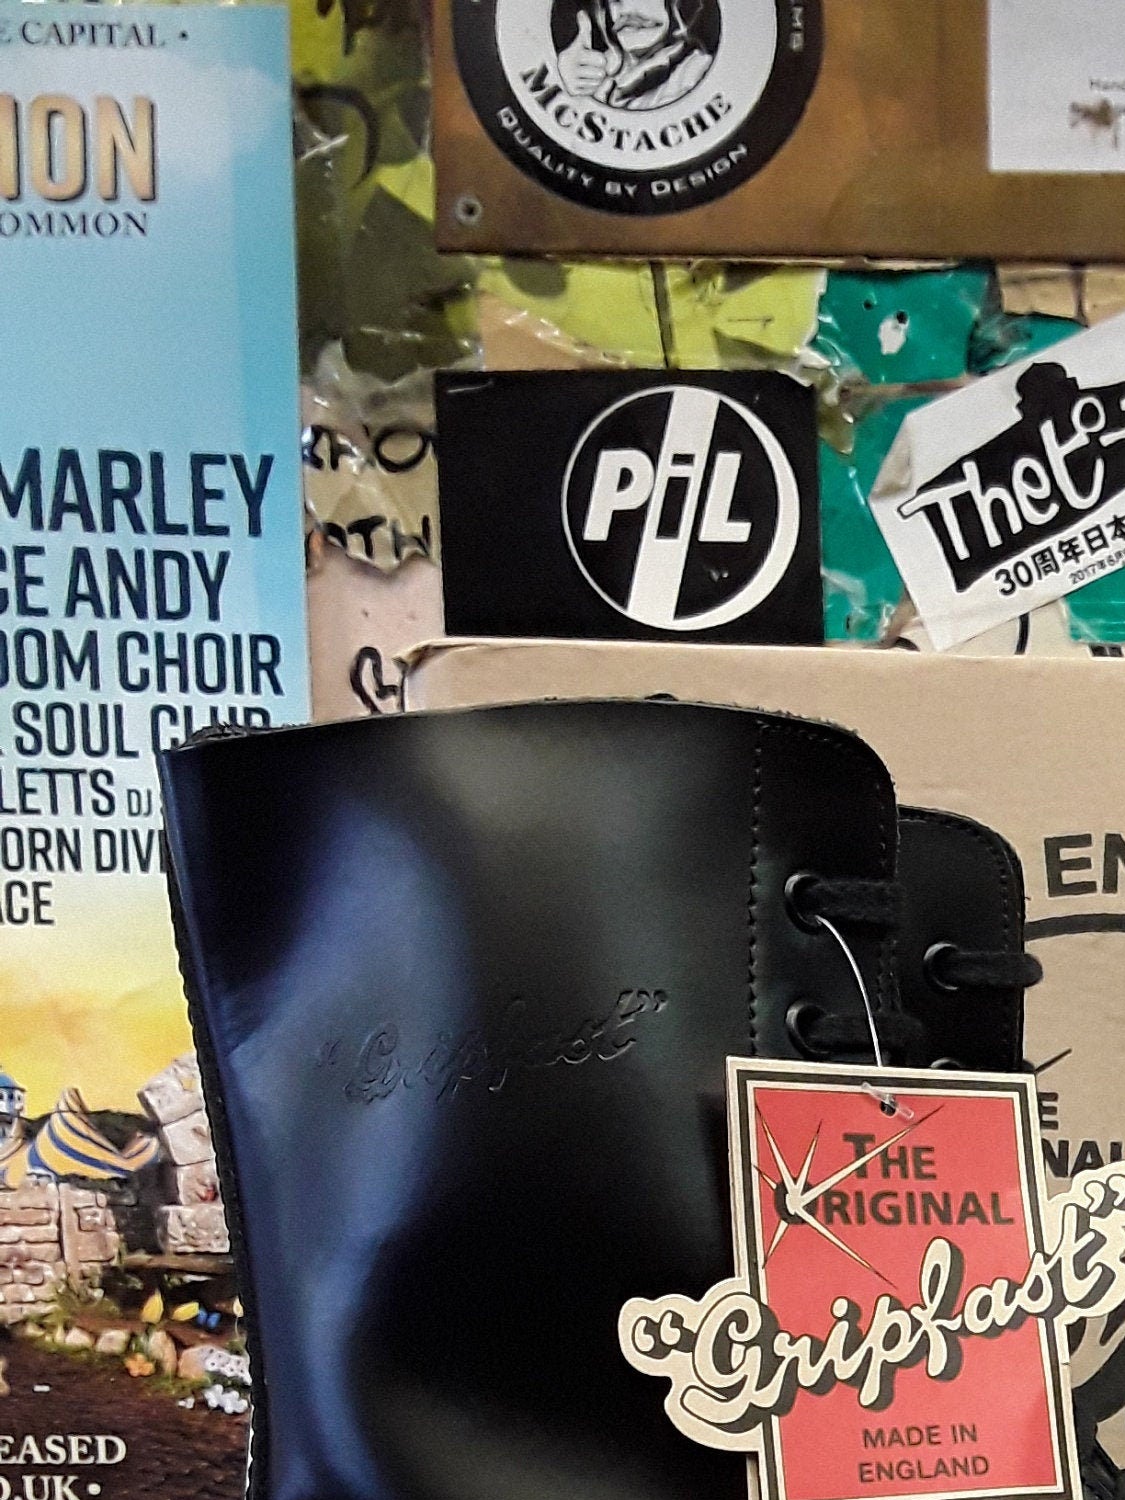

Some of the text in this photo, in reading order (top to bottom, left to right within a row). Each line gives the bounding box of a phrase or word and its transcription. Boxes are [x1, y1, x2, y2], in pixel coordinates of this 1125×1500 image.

[21, 20, 166, 46] CAPITAL
[497, 106, 748, 198] QUALITY BY DESIGN
[0, 448, 276, 538] MARLEY
[583, 448, 752, 542] PiL
[65, 546, 231, 622] ANDY
[117, 631, 285, 697] CHOIR
[13, 701, 139, 758] SOUL
[127, 787, 152, 818] DJ
[0, 880, 54, 925] CE
[843, 1133, 936, 1181] THE
[774, 1181, 1015, 1228] ORIGINAL
[862, 1423, 978, 1450] MADE IN
[857, 1455, 991, 1485] ENGLAND
